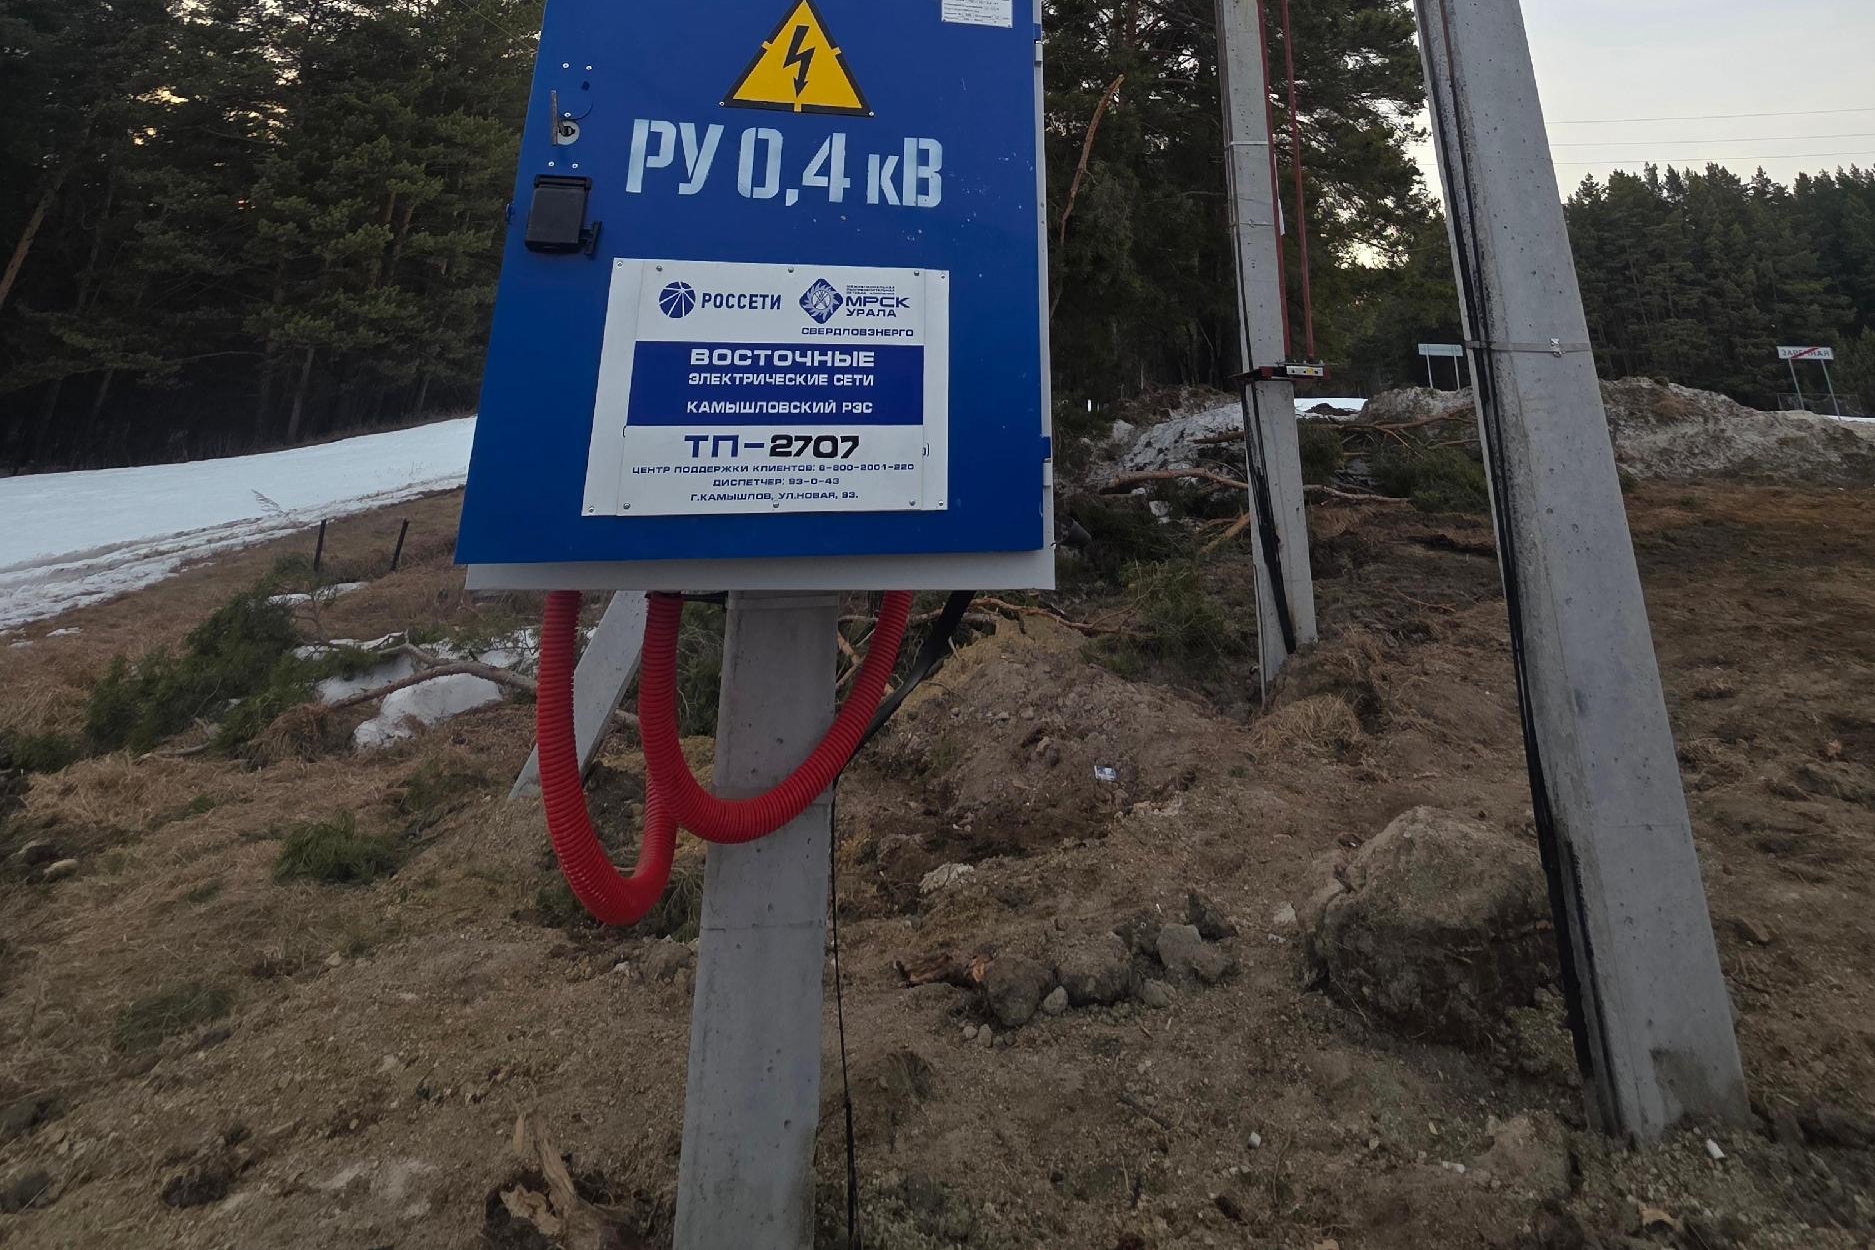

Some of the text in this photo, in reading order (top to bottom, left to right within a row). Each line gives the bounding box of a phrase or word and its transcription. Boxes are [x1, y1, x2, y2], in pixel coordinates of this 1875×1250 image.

[625, 118, 944, 208] РУ 0,4 кВ
[701, 292, 782, 310] РОССЕТИ
[845, 295, 911, 309] МРСК
[845, 308, 897, 318] УРАЛА
[801, 327, 914, 337] СВЕРДЛОВЭНЕРГО
[690, 348, 875, 367] ВОСТОЧНЫЕ
[688, 373, 874, 386] ЭЛЕКТРИЧЕСКИЕ СЕТИ
[687, 399, 873, 414] КАМЫШЛОВСКИЙ РЭС
[684, 434, 860, 460] ТП-2707
[632, 466, 671, 475] ЦЕНТР
[674, 465, 749, 474] ПОДДЕРЖКИ
[752, 464, 816, 472] КЛИЕНТОВ:
[713, 478, 785, 487] ДИСПЕТЧЕР:
